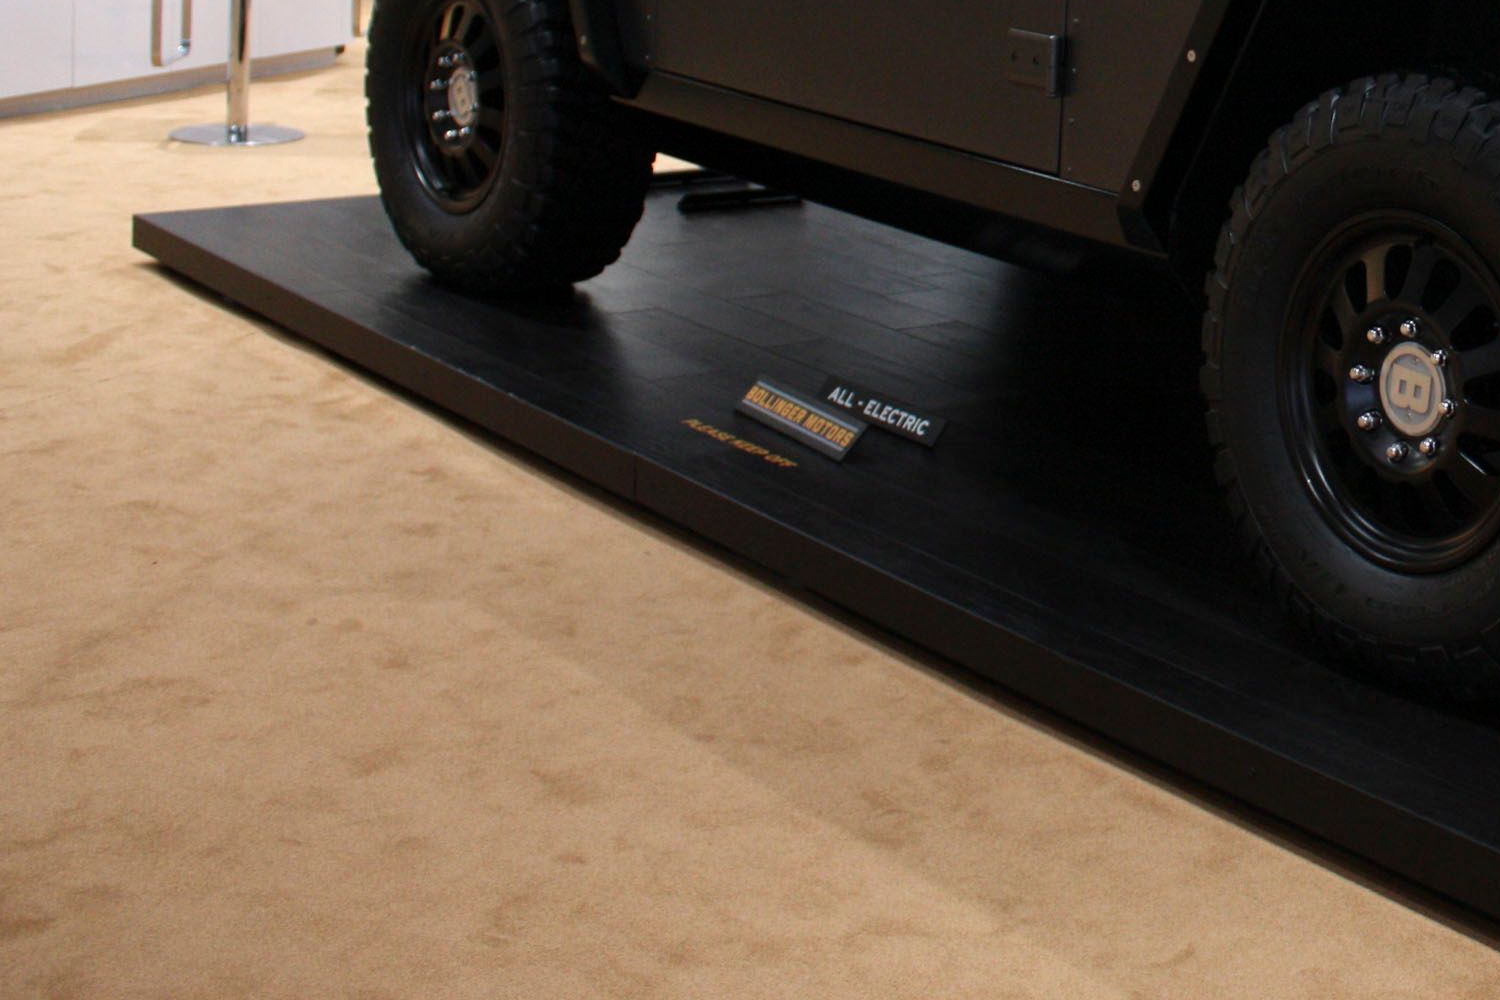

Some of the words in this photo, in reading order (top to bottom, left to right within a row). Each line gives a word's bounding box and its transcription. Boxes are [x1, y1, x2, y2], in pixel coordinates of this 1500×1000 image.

[745, 385, 808, 423] BOLLINGER
[802, 413, 855, 448] MOTORS
[827, 387, 855, 408] ALL
[863, 399, 930, 436] ELECTRIC
